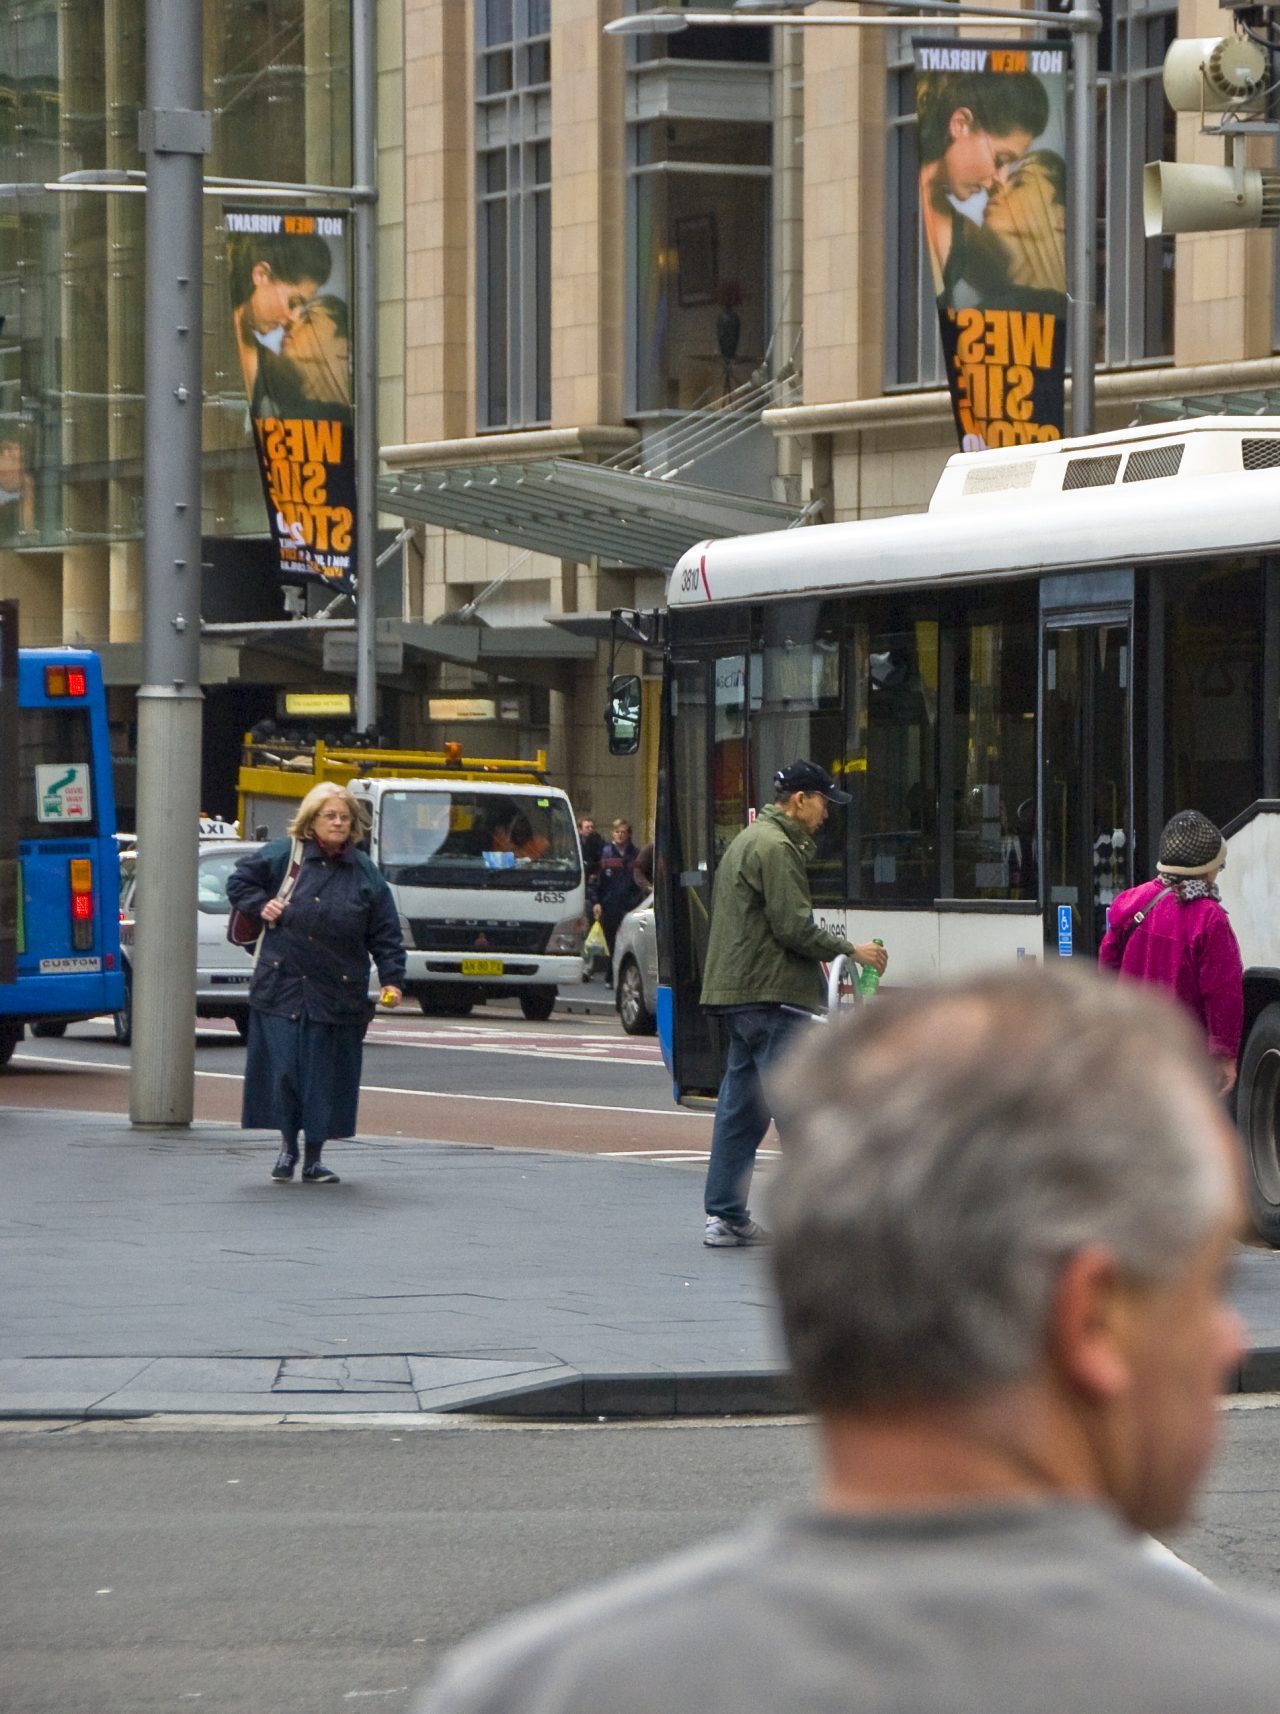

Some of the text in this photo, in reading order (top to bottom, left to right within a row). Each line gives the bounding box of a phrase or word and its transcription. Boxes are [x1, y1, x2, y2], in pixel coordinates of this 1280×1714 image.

[681, 568, 699, 592] 3810
[534, 891, 566, 904] 4635
[42, 958, 99, 969] CUSTOM
